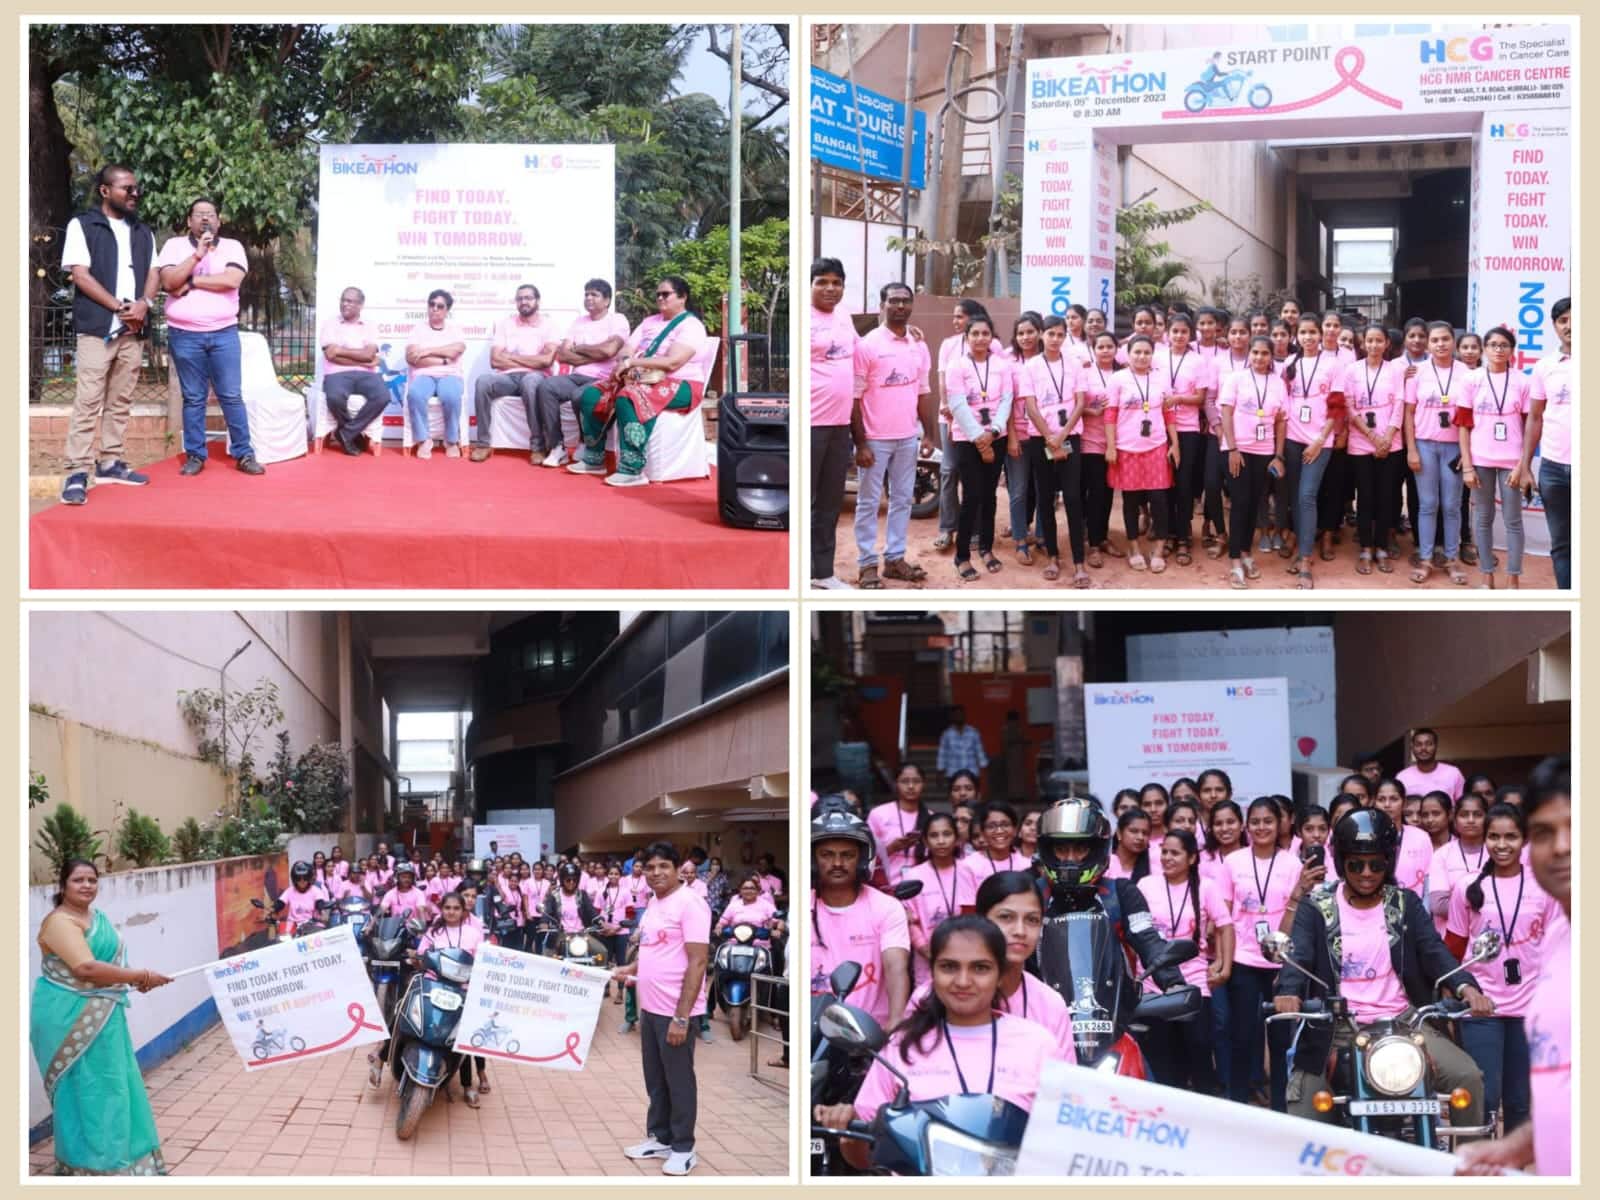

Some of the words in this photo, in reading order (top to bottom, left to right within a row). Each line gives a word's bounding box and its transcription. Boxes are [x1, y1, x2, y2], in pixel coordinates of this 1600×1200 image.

[1420, 36, 1494, 63] HCG
[1499, 40, 1516, 50] The
[1519, 38, 1566, 51] Specialist
[1227, 49, 1277, 66] START
[1283, 45, 1332, 63] POINT
[1510, 50, 1544, 60] Cancer
[1546, 49, 1569, 58] Care
[1420, 72, 1442, 86] HCG
[1446, 71, 1472, 84] NMR
[1476, 68, 1521, 83] CANCER
[1525, 66, 1570, 81] CENTRE
[1032, 71, 1167, 99] BIKEATHON
[1031, 100, 1072, 111] Saturday,
[1095, 96, 1140, 106] December
[1143, 93, 1166, 103] 2023
[1106, 108, 1121, 117] AM
[843, 104, 918, 145] TOURIST
[1491, 123, 1529, 138] HCG
[1512, 149, 1544, 164] FIND
[332, 160, 418, 175] BIKEATHON
[1045, 162, 1069, 174] FIND
[1505, 171, 1550, 185] TODAY.
[1040, 180, 1073, 193] TODAY.
[415, 189, 450, 204] FIND
[456, 189, 510, 204] TODAY.
[1507, 192, 1546, 207] FIGHT
[1042, 199, 1071, 212] FIGHT
[413, 210, 457, 225] FIGHT
[462, 210, 517, 225] TODAY.
[1040, 217, 1073, 230] TODAY.
[1504, 213, 1549, 229] TODAY.
[398, 231, 427, 246] WIN
[434, 231, 527, 247] TOMORROW.
[1045, 236, 1066, 249] WIN
[1512, 235, 1539, 250] WIN
[1025, 255, 1087, 268] TOMORROW.
[1484, 256, 1566, 272] TOMORROW.
[1226, 686, 1253, 697] HCG
[1094, 694, 1154, 705] BIKEATHON
[1152, 713, 1178, 723] FIND
[1181, 712, 1218, 723] TODAY.
[1152, 728, 1183, 739] FIGHT
[1187, 727, 1223, 738] TODAY.
[1142, 743, 1163, 754] WIN
[1167, 741, 1231, 753] TOMORROW.
[296, 935, 323, 953] HCG
[227, 977, 248, 993] FIND
[249, 973, 281, 988] TODAY.
[283, 963, 310, 980] FIGHT
[312, 953, 345, 971] TODAY.
[483, 984, 502, 995] WIN
[486, 970, 506, 983] FIND
[538, 979, 561, 993] FIGHT
[563, 983, 590, 999] TODAY.
[231, 994, 249, 1008] WIN
[251, 980, 307, 1003] TOMORROW.
[1056, 1102, 1190, 1150] BIKEATHON
[1299, 1141, 1368, 1176] HCG
